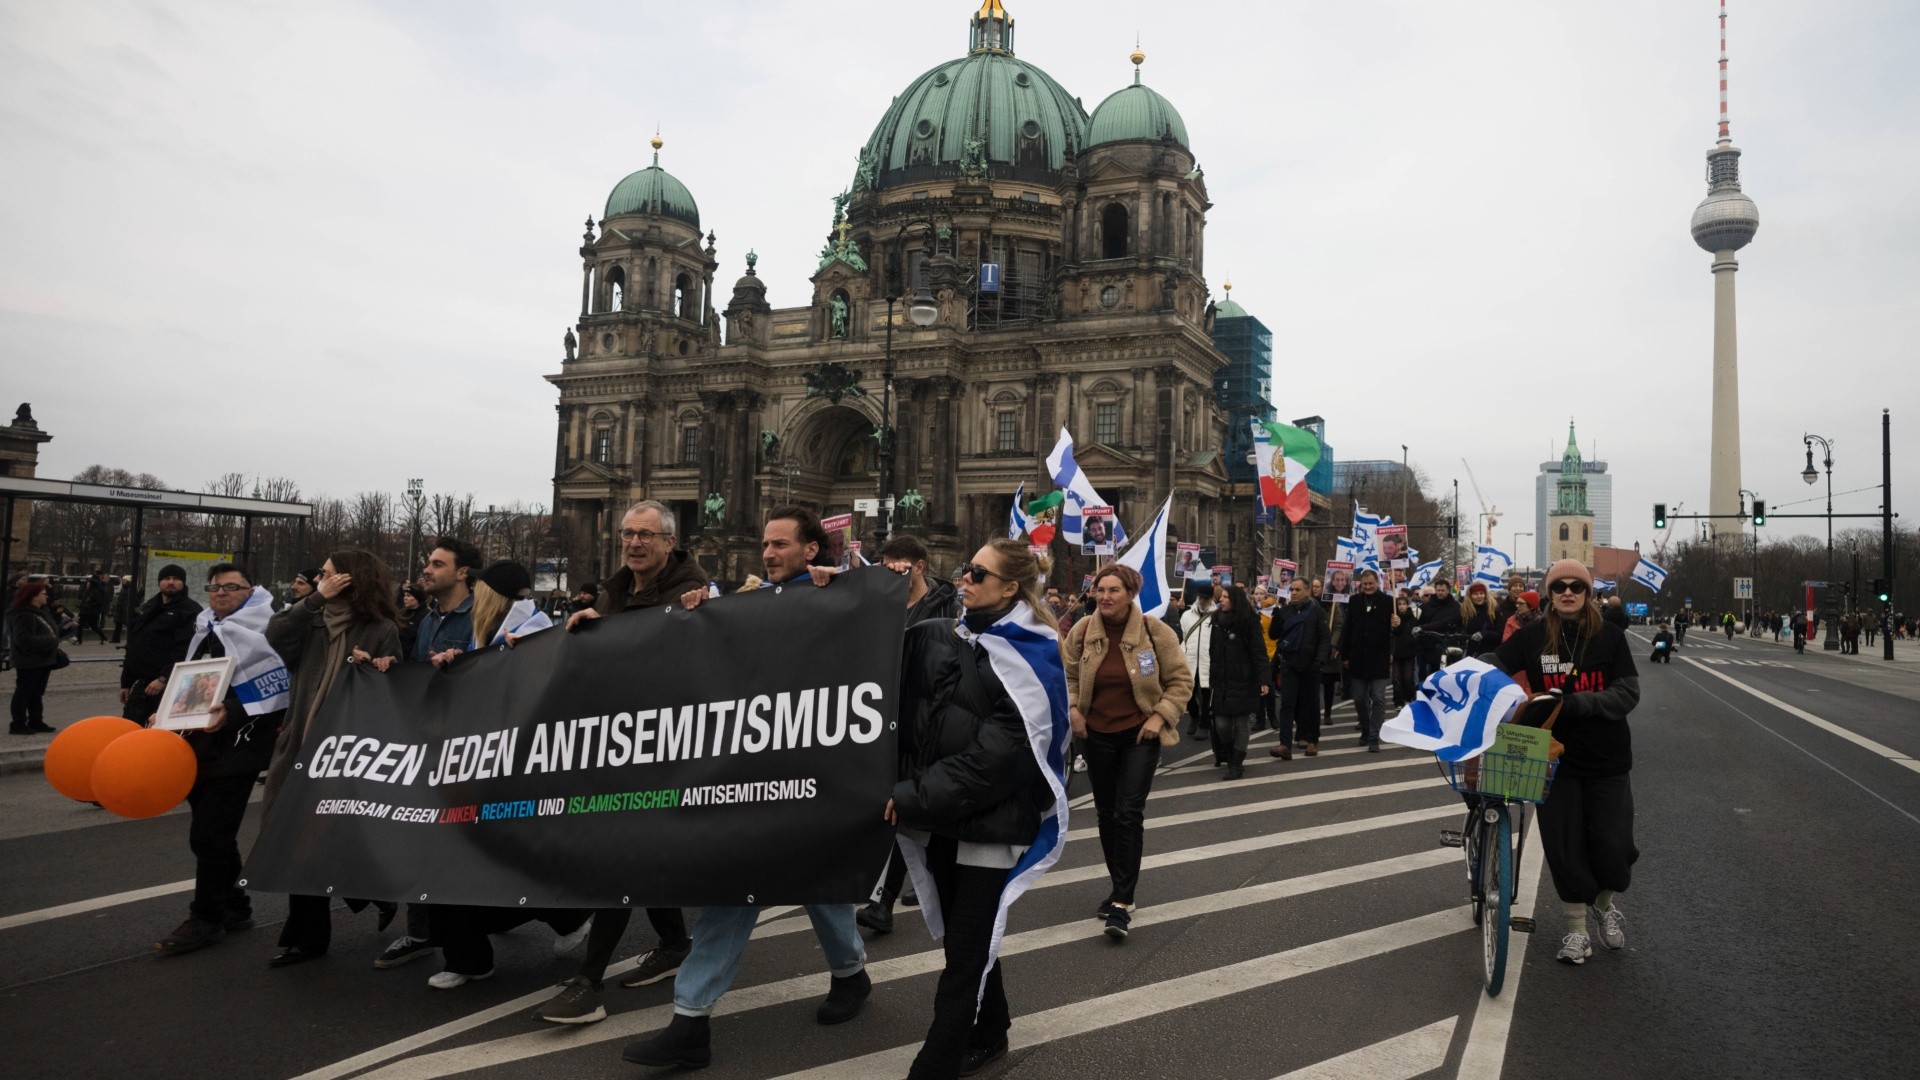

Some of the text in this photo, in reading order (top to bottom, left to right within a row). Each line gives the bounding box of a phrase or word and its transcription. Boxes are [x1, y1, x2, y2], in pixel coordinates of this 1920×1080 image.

[116, 490, 162, 500] Museumsinsel
[824, 518, 849, 529] ENTFÜHRT
[1541, 654, 1560, 664] BRING
[1542, 663, 1558, 674] THEM
[308, 682, 883, 787] GEGEN JEDEN ANTISEMITISMUS
[1521, 738, 1539, 746] group
[315, 778, 818, 824] GEMEINSAM GEGEN LINKEN, RECHTEN UND ISLAMISTISCHEN ANTISEMITISMUS
